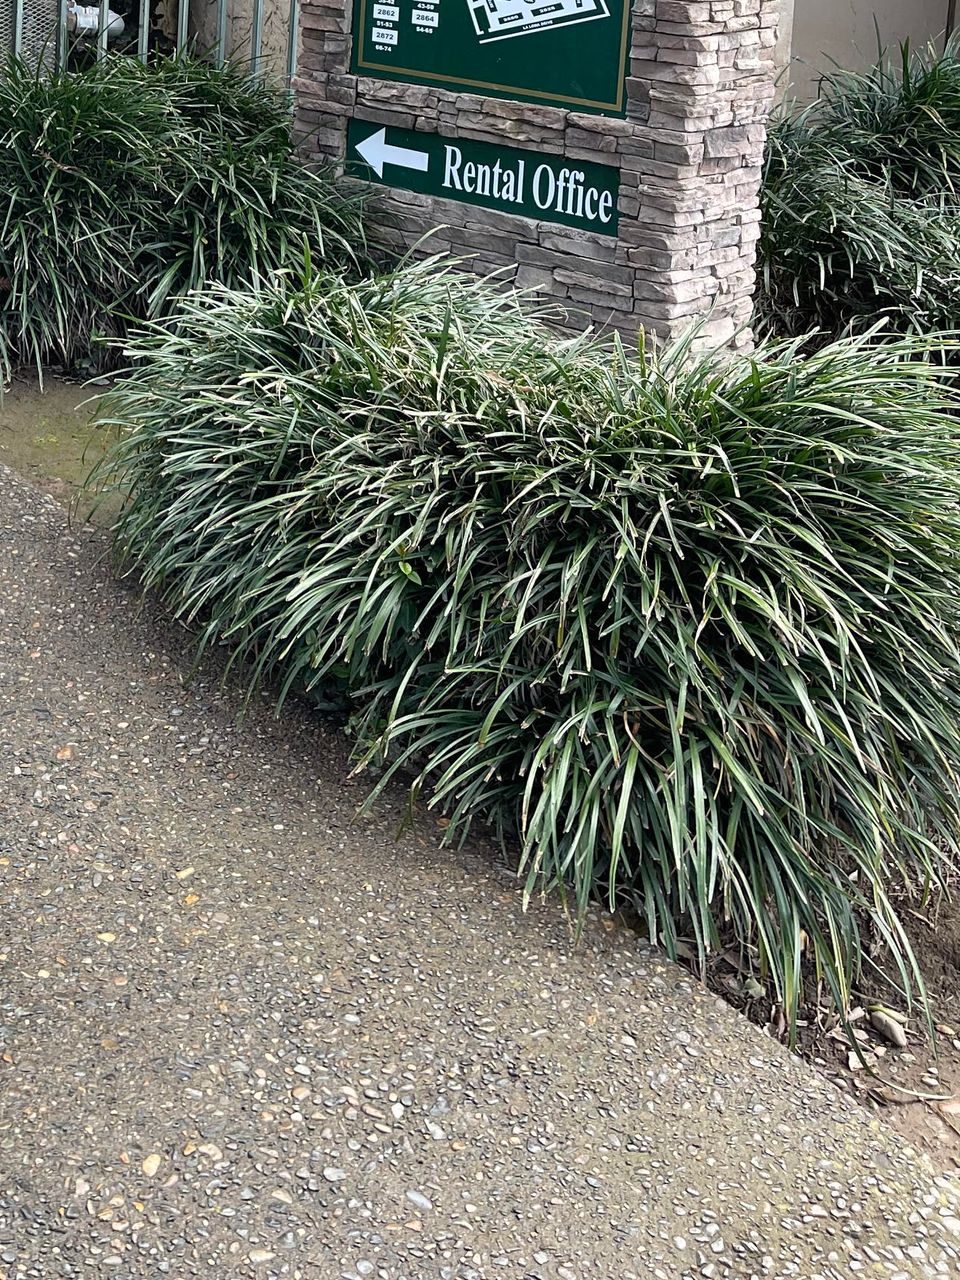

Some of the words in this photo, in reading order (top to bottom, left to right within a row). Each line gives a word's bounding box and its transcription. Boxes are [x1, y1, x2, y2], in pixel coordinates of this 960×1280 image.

[377, 8, 395, 17] 2862
[416, 14, 435, 22] 2864
[376, 31, 394, 40] 2872
[442, 144, 525, 204] Rental
[532, 163, 613, 224] Office
